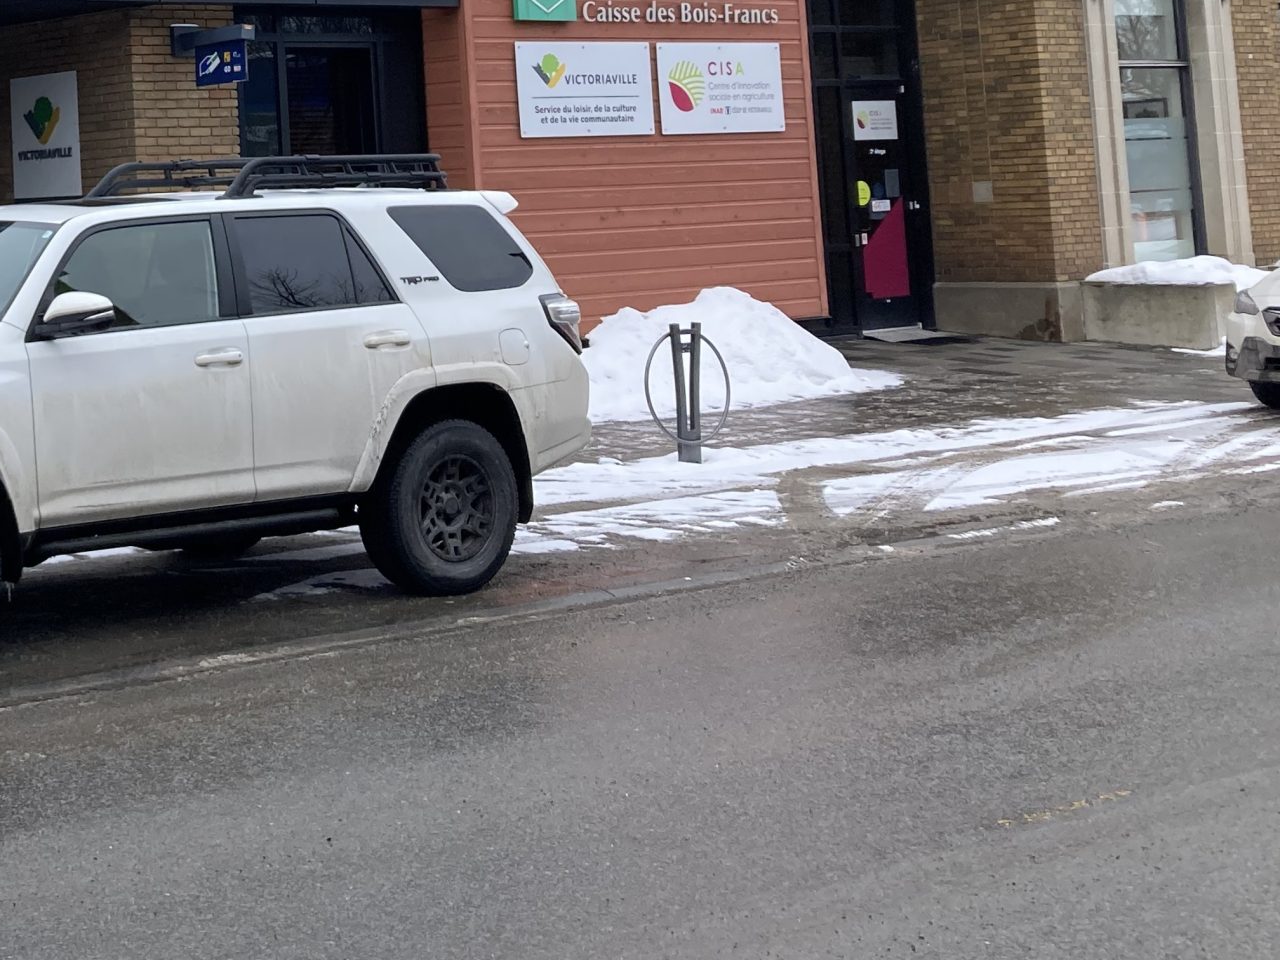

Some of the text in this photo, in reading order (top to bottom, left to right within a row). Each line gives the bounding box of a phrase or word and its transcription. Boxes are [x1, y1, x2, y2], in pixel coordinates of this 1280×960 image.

[583, 1, 778, 23] Caisse des Bois-Francs
[708, 61, 744, 76] CISA
[565, 74, 637, 85] VICTORIAVILLE
[535, 104, 636, 114] Service du loisir, de la culture
[540, 115, 634, 124] et de la vie communautaire
[18, 147, 72, 161] VICTORIAVILLE
[400, 276, 422, 285] TRD
